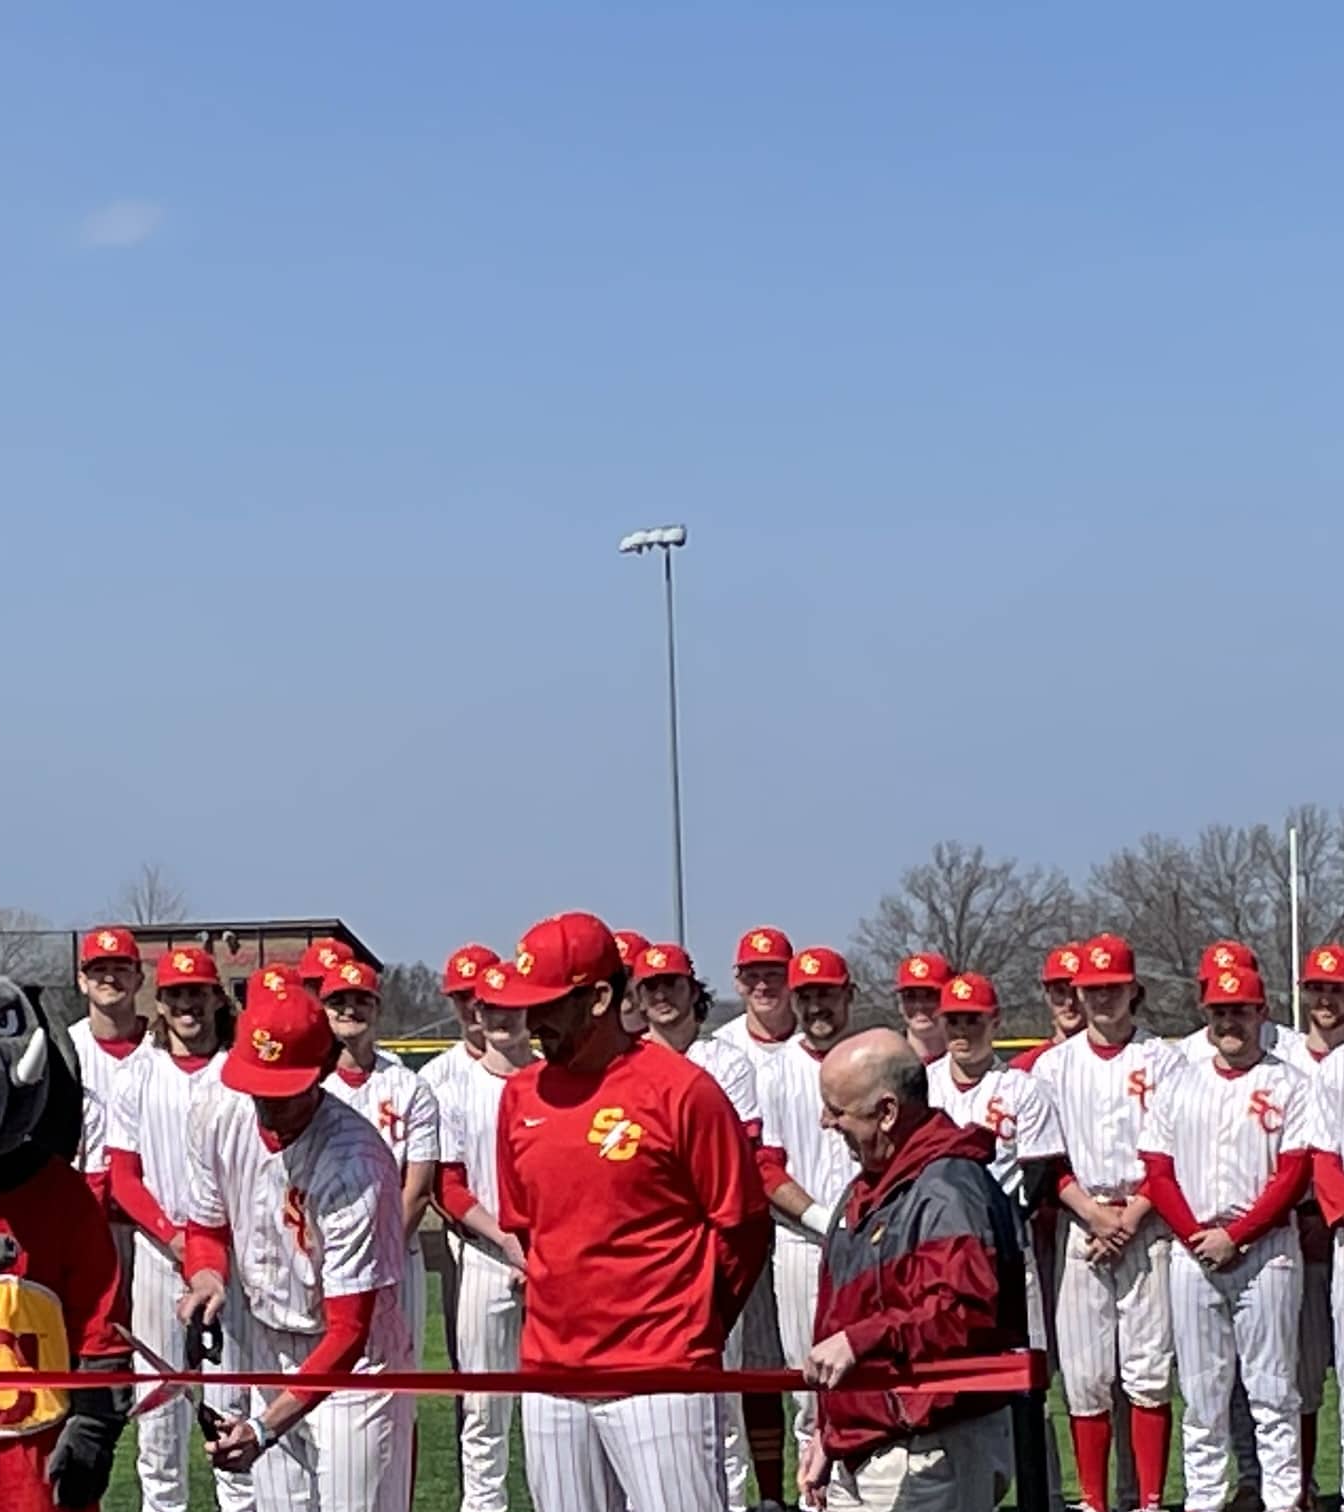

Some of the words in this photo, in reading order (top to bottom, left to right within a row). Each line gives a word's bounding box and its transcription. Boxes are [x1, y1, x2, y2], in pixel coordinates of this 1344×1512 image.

[587, 1107, 643, 1161] SC
[985, 1095, 1017, 1140] SC
[1248, 1088, 1283, 1134] SC
